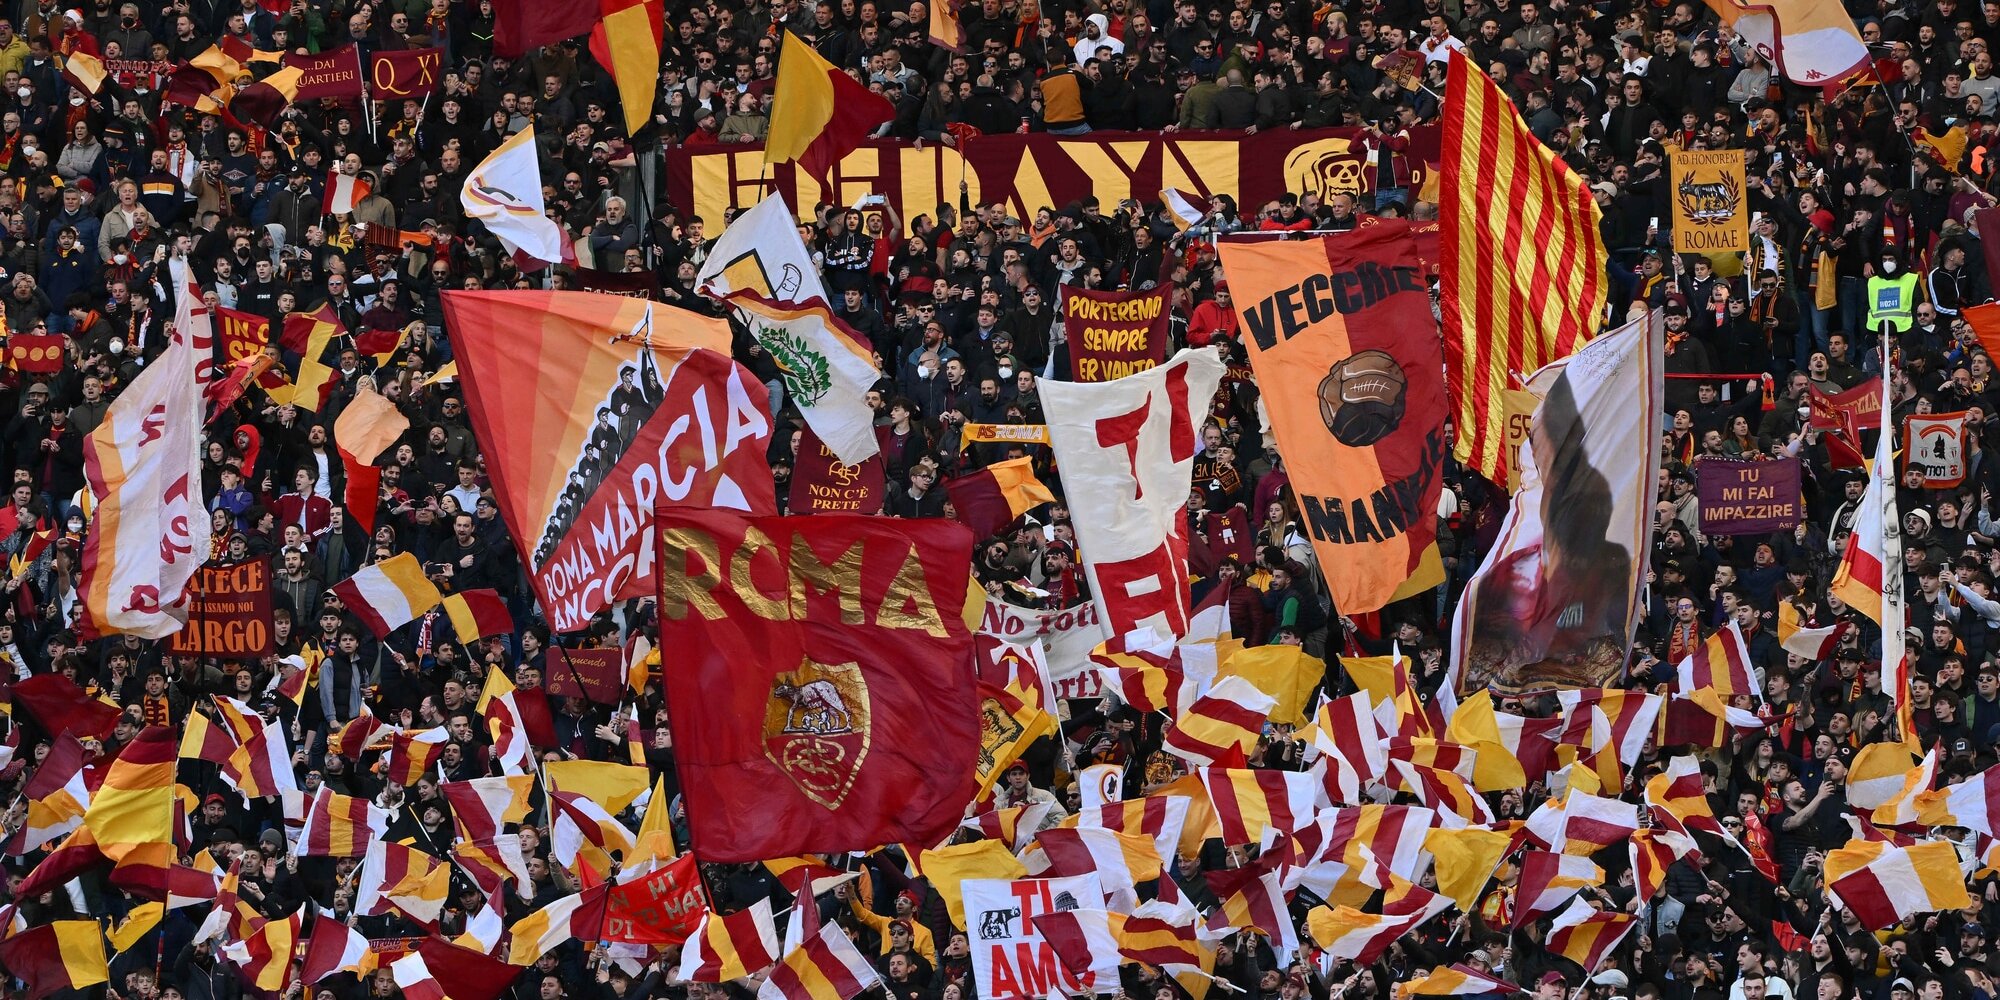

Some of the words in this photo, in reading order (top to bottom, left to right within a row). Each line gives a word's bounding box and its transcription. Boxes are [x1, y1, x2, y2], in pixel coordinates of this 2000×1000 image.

[1691, 153, 1739, 165] HONOREM
[1684, 230, 1739, 249] ROMAE
[1068, 295, 1163, 321] PORTEREMO
[1083, 327, 1149, 352] SEMPRE
[1079, 358, 1099, 381] ER
[544, 538, 595, 604] ROMA
[590, 361, 768, 566] MARCIA
[1738, 469, 1759, 482] TU
[808, 484, 840, 498] NON
[1723, 488, 1742, 501] MI
[1748, 486, 1774, 500] FAI
[812, 498, 860, 510] PRETE
[1705, 504, 1793, 520] IMPAZZIRE
[663, 526, 951, 638] ROMA
[238, 602, 254, 612] NOI
[172, 619, 266, 653] LARGO
